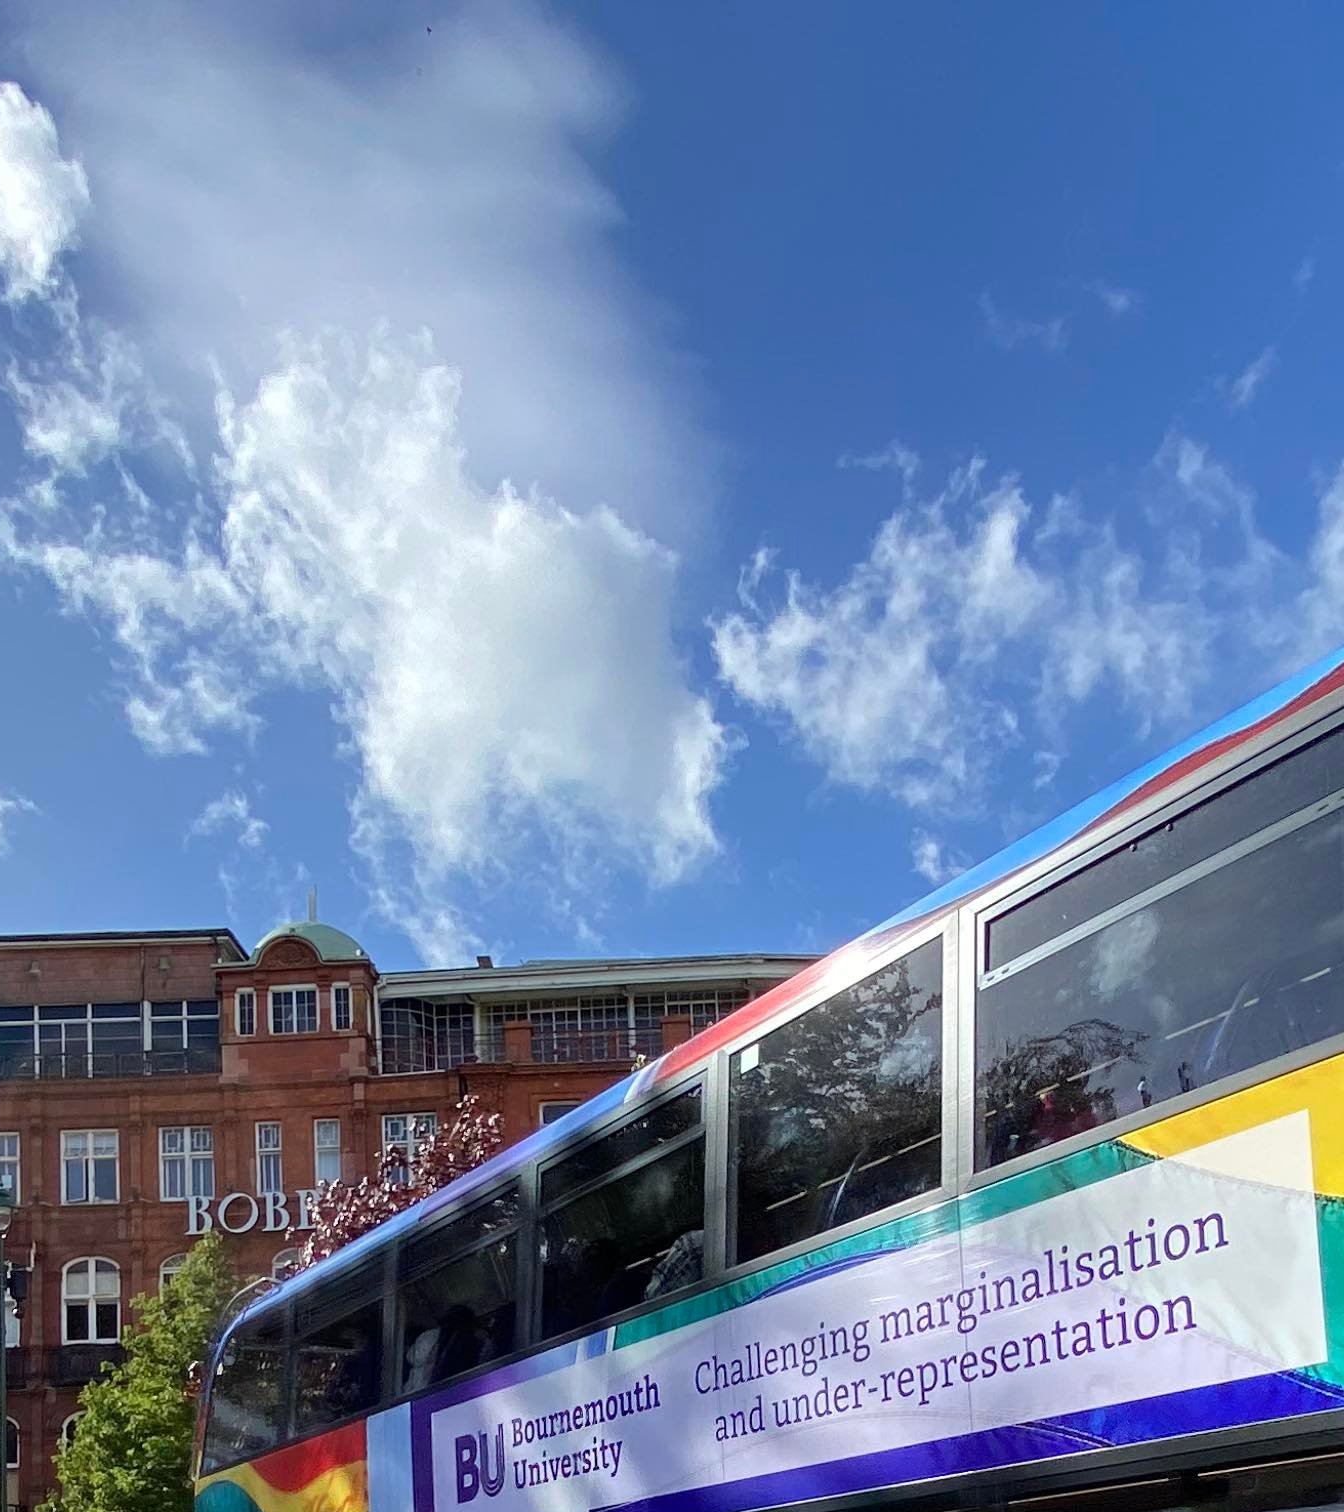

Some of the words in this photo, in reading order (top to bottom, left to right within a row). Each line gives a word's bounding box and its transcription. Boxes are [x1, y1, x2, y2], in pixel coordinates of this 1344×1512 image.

[694, 1315, 871, 1396] Challenging
[879, 1211, 1229, 1334] marginalisation
[714, 1395, 766, 1442] and
[772, 1293, 1198, 1428] under-representation
[512, 1374, 661, 1448] Bournemouth
[456, 1423, 506, 1504] BU
[513, 1437, 623, 1490] University
